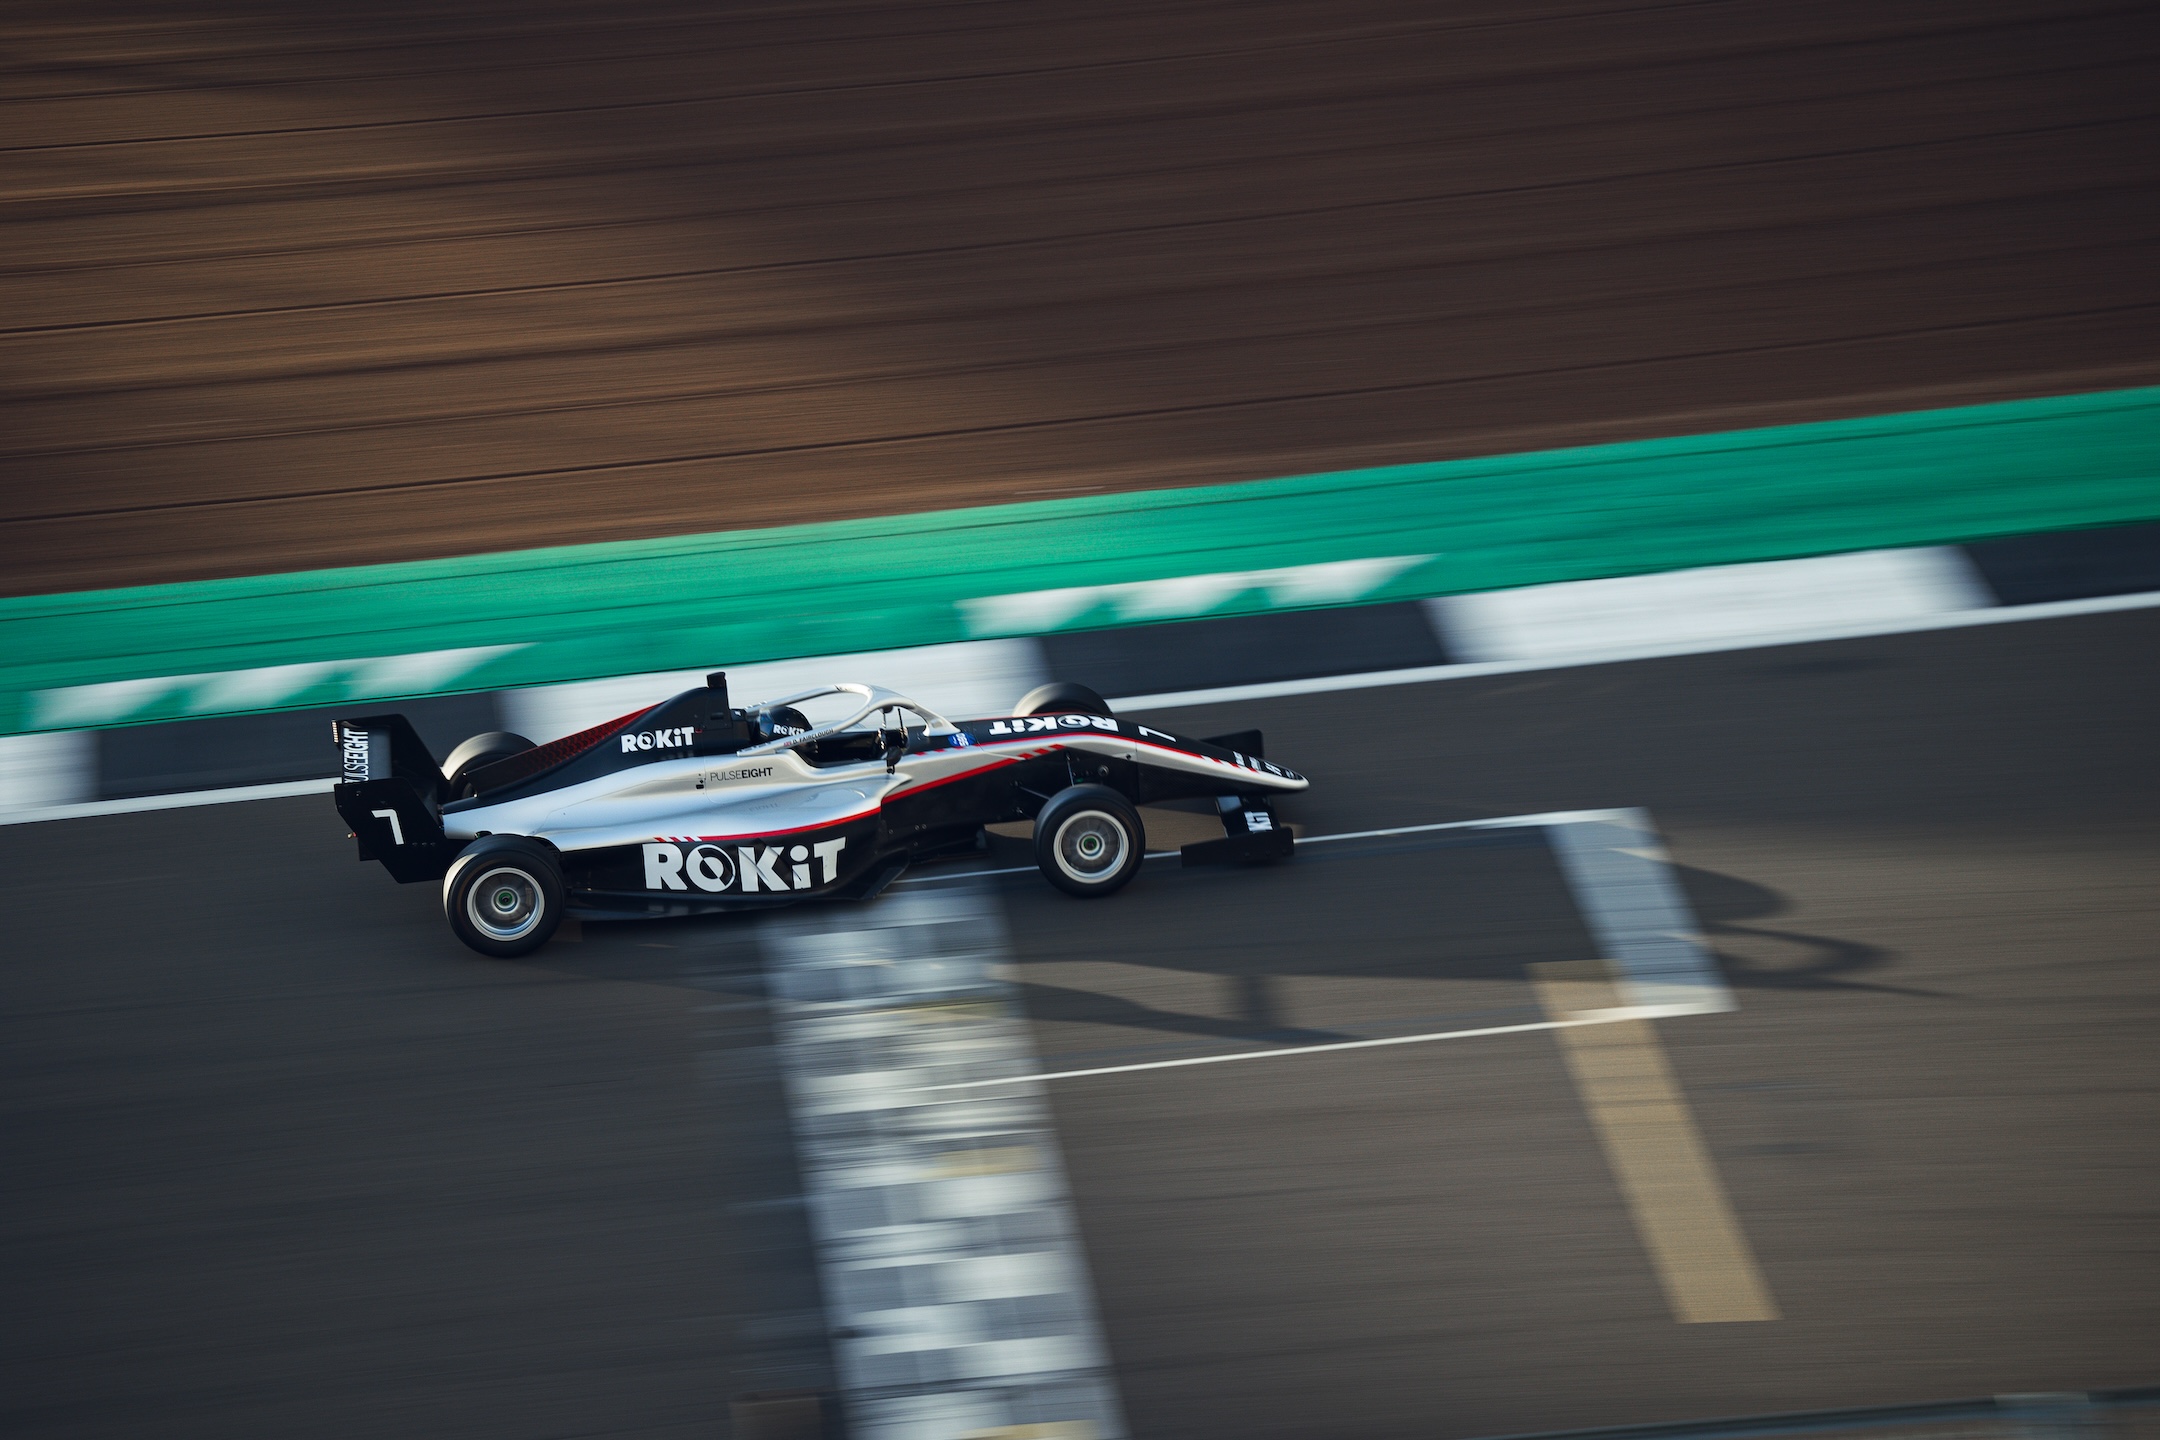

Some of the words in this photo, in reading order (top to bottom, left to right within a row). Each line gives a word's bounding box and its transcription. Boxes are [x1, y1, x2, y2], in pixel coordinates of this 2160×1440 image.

[621, 726, 695, 753] ROKiT
[799, 727, 834, 744] FAIRCLOUGH
[1136, 725, 1177, 743] 7
[710, 767, 773, 781] PULSEEIGHT
[370, 808, 405, 845] 7
[641, 836, 847, 893] ROKiT
